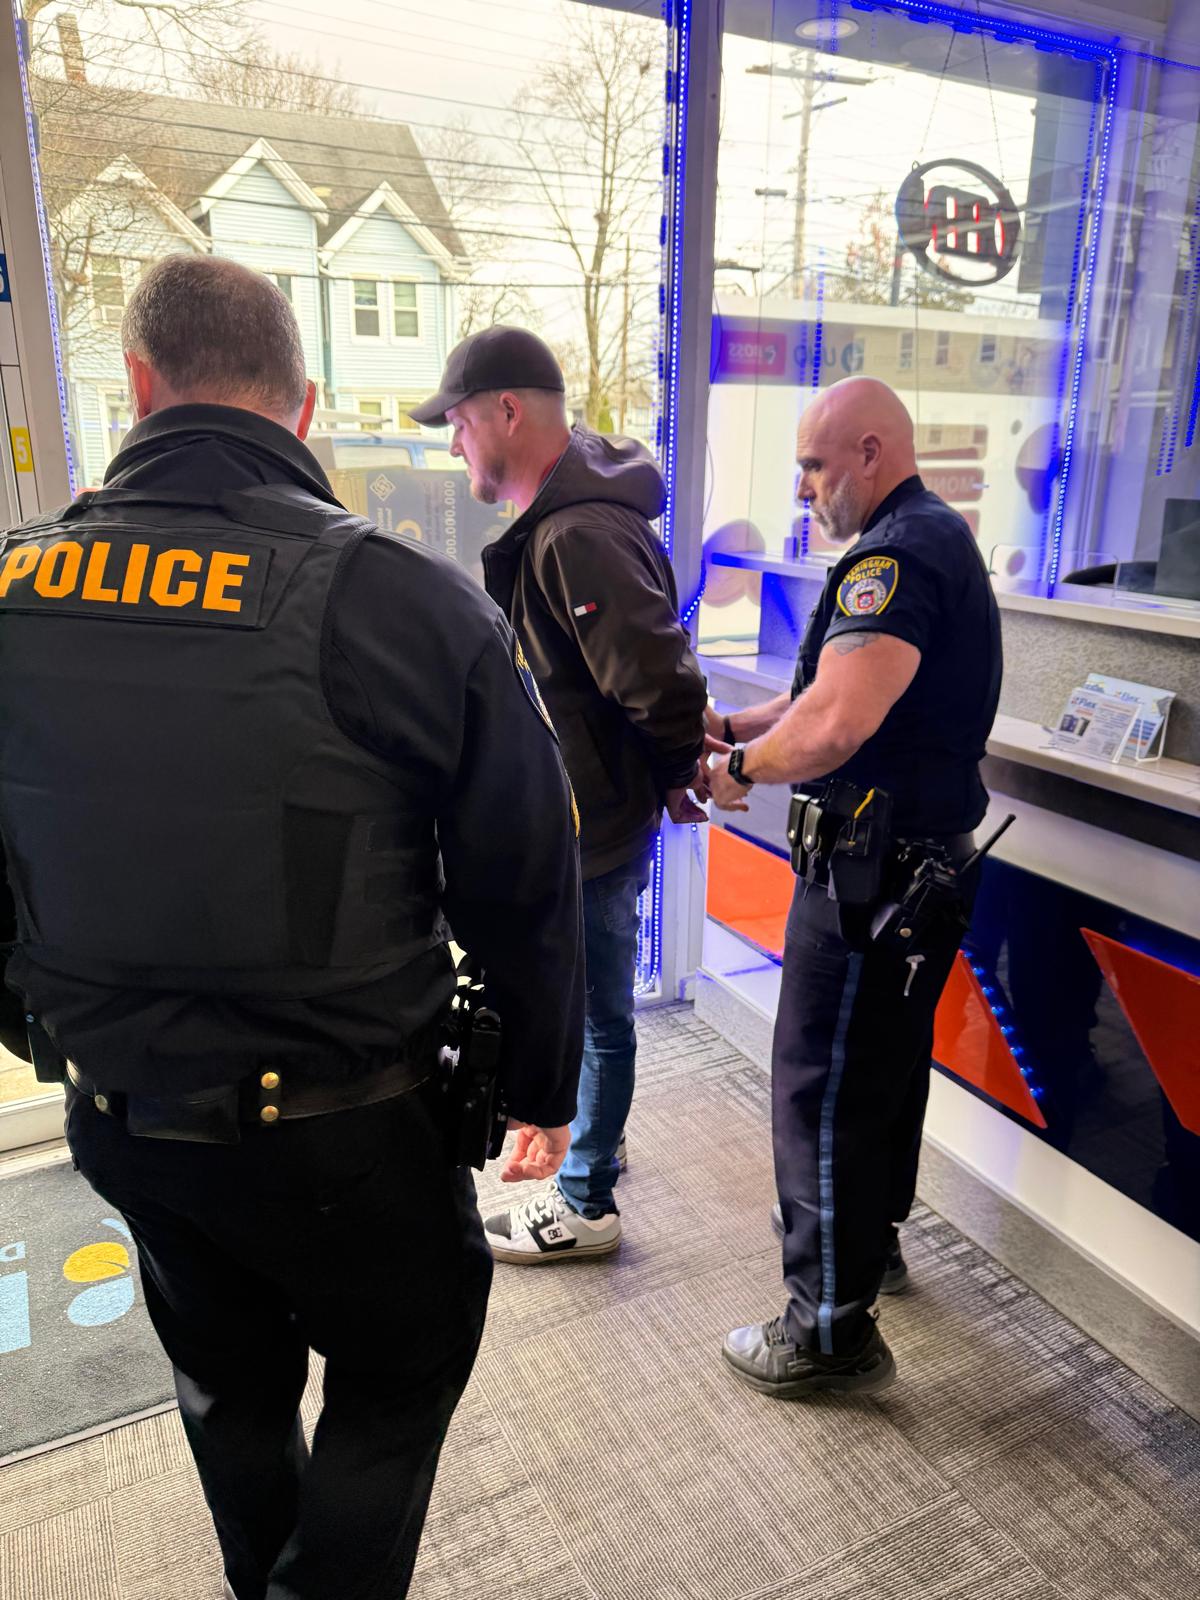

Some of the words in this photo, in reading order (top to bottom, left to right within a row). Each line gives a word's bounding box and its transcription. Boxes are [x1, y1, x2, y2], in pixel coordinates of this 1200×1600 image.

[15, 436, 28, 464] 5
[0, 541, 250, 612] POLICE
[848, 567, 882, 585] POLICE
